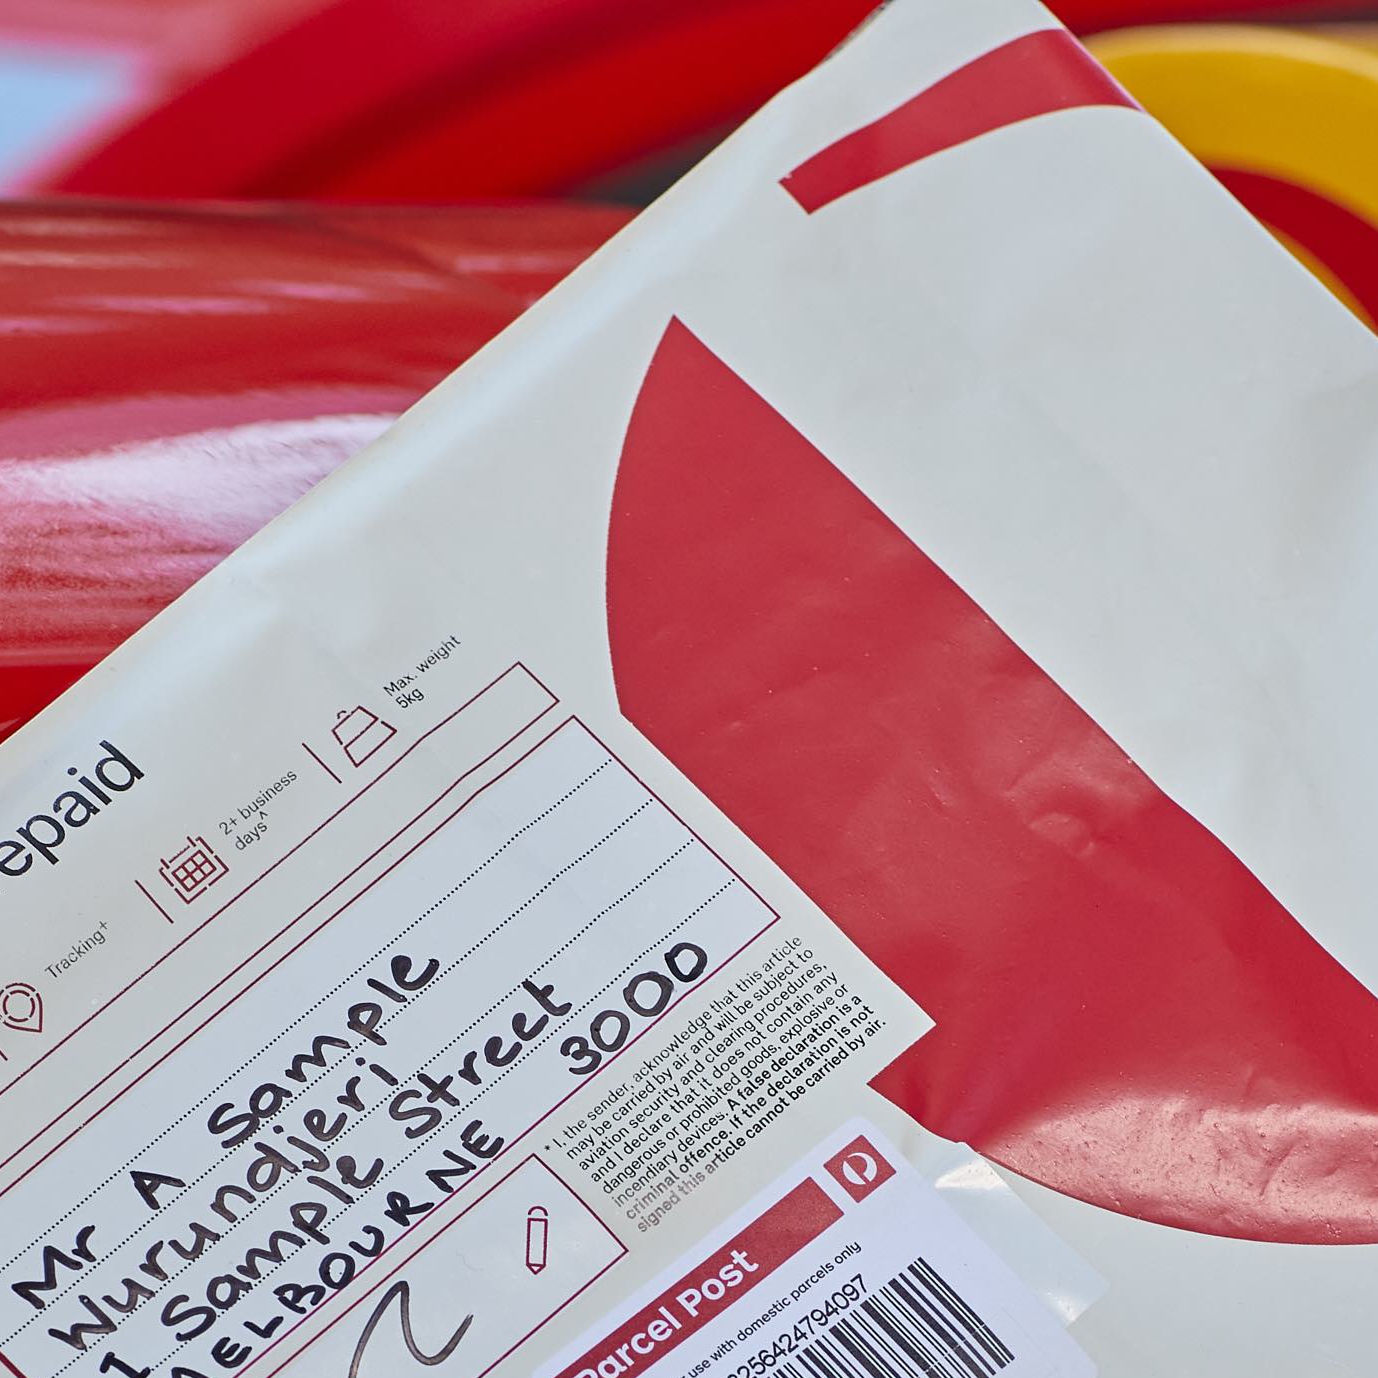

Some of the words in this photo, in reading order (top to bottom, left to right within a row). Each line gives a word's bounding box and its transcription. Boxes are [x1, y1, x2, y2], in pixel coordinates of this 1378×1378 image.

[383, 675, 418, 696] Max.
[415, 635, 461, 672] weight
[395, 688, 425, 708] 5kg
[218, 817, 237, 835] 2+
[237, 771, 297, 819] business
[560, 942, 708, 1076] 3000
[579, 1127, 630, 1170] aviation
[628, 1083, 680, 1128] security
[704, 1020, 756, 1063] clearing
[753, 963, 827, 1024] procedures,
[587, 1083, 634, 1120] sender,
[632, 1011, 712, 1082] acknowledge
[709, 989, 738, 1017] that
[735, 971, 763, 992] this
[762, 937, 802, 972] article
[612, 1079, 657, 1121] carried
[713, 1010, 738, 1031] will
[753, 959, 800, 1001] subject
[623, 1113, 672, 1154] declare
[669, 1087, 701, 1113] that
[712, 1048, 745, 1078] does
[766, 993, 814, 1032] contain
[677, 1111, 729, 1152] devices.
[736, 1070, 772, 1100] false
[770, 1014, 840, 1072] declaration
[11, 1223, 99, 1309] Mr
[130, 1169, 186, 1209] A
[207, 952, 440, 1149] Sample
[161, 1152, 384, 1344] Sample
[388, 978, 573, 1140] Street
[602, 1139, 666, 1193] dangerous
[679, 1071, 742, 1131] prohibited
[740, 1044, 782, 1078] goods,
[779, 996, 835, 1043] explosive
[679, 1130, 733, 1173] offence.
[767, 1037, 838, 1096] declaration
[704, 1137, 746, 1173] article
[745, 1097, 790, 1138] cannot
[805, 1046, 849, 1087] carried
[864, 1019, 886, 1036] air.
[48, 1057, 400, 1351] Wurundjeri
[675, 1249, 759, 1317] Post
[687, 1359, 711, 1378] use
[709, 1339, 738, 1360] with
[737, 1297, 791, 1341] domestic
[789, 1262, 835, 1301] parcels
[834, 1241, 862, 1264] only
